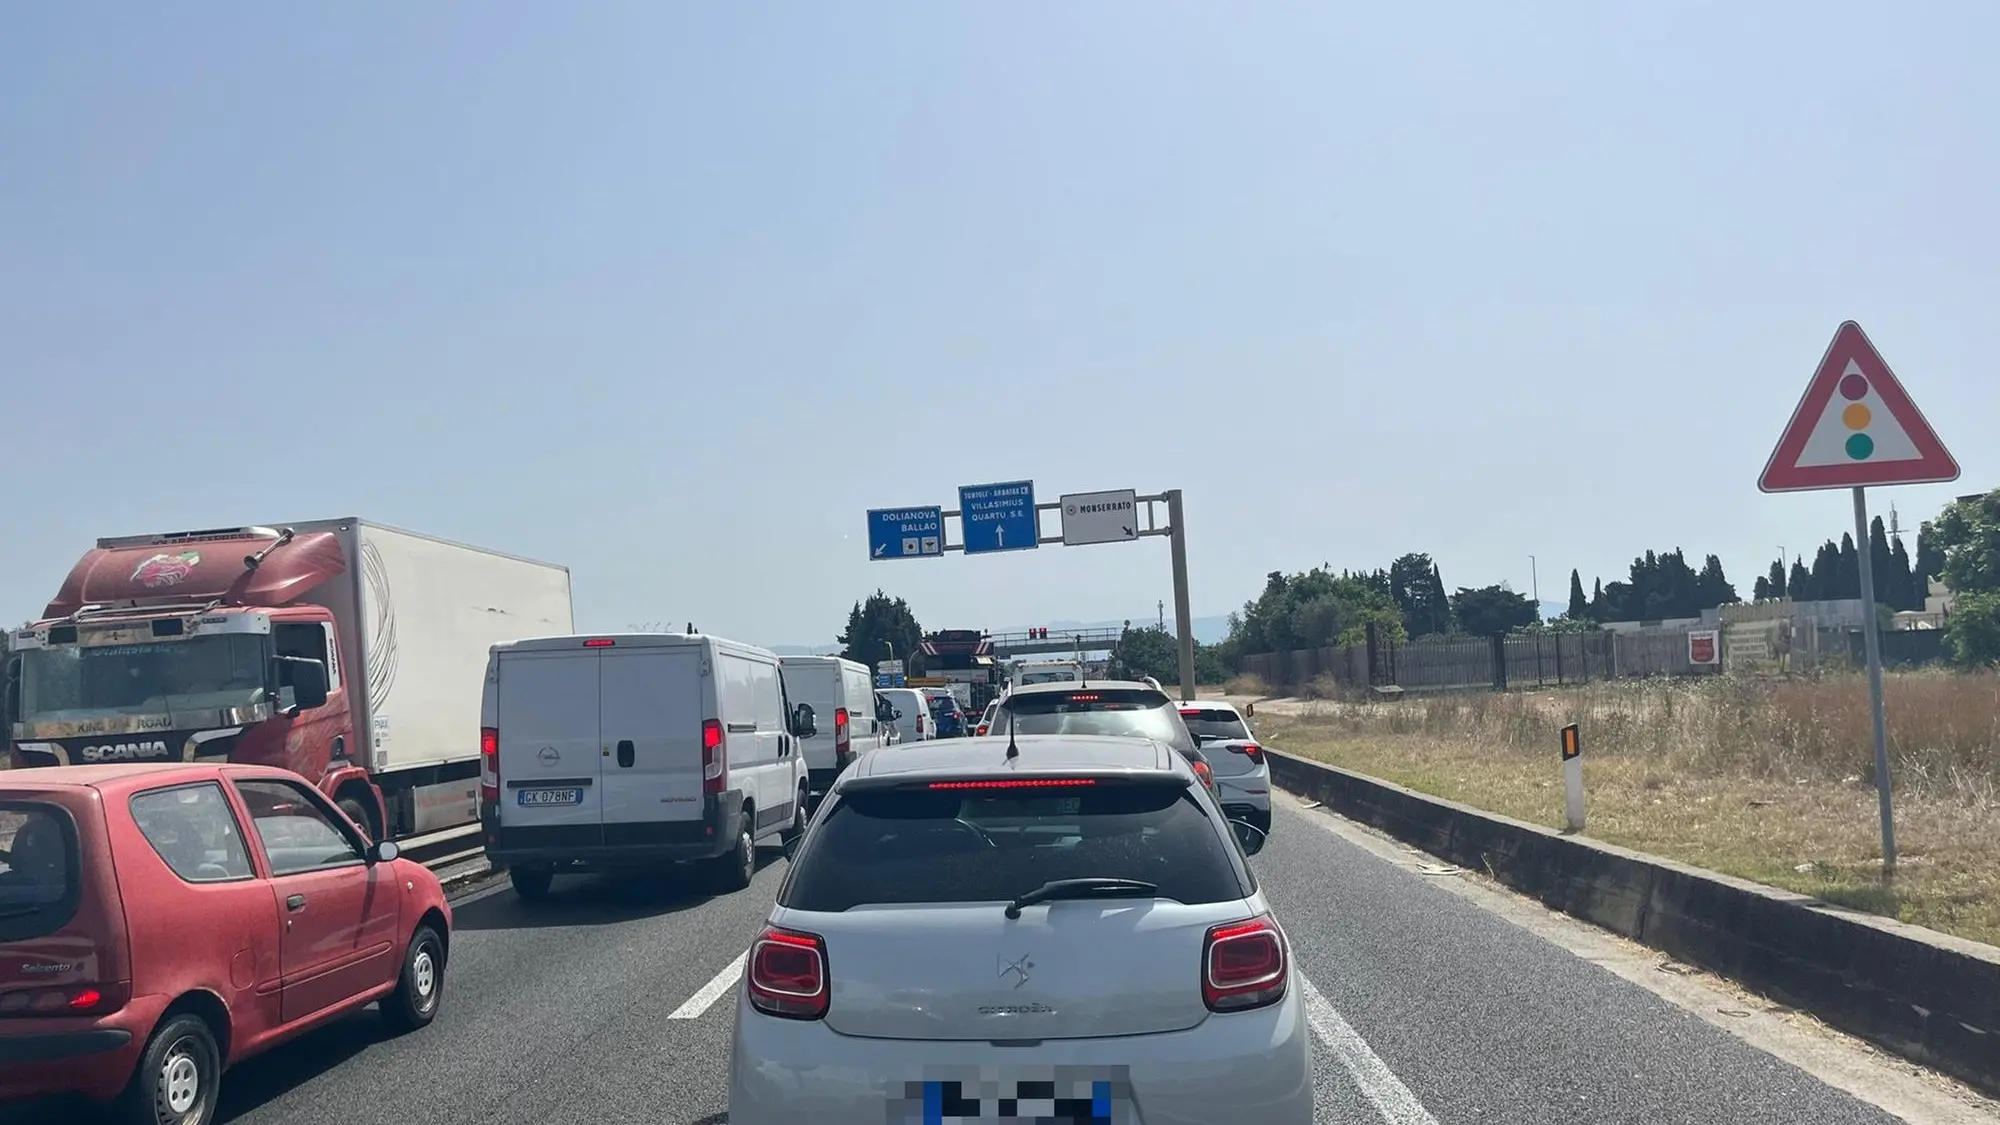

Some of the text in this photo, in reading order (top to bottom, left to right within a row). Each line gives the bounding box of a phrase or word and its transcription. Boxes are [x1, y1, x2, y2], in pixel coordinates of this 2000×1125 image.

[970, 499, 1024, 510] VILLASIMIUS
[1080, 501, 1131, 514] MONSERRATO
[882, 510, 937, 522] DOLIANOVA
[971, 511, 1006, 521] QUARTU
[901, 522, 937, 532] BALLAO
[82, 741, 169, 760] SCANIA
[525, 791, 538, 803] GK
